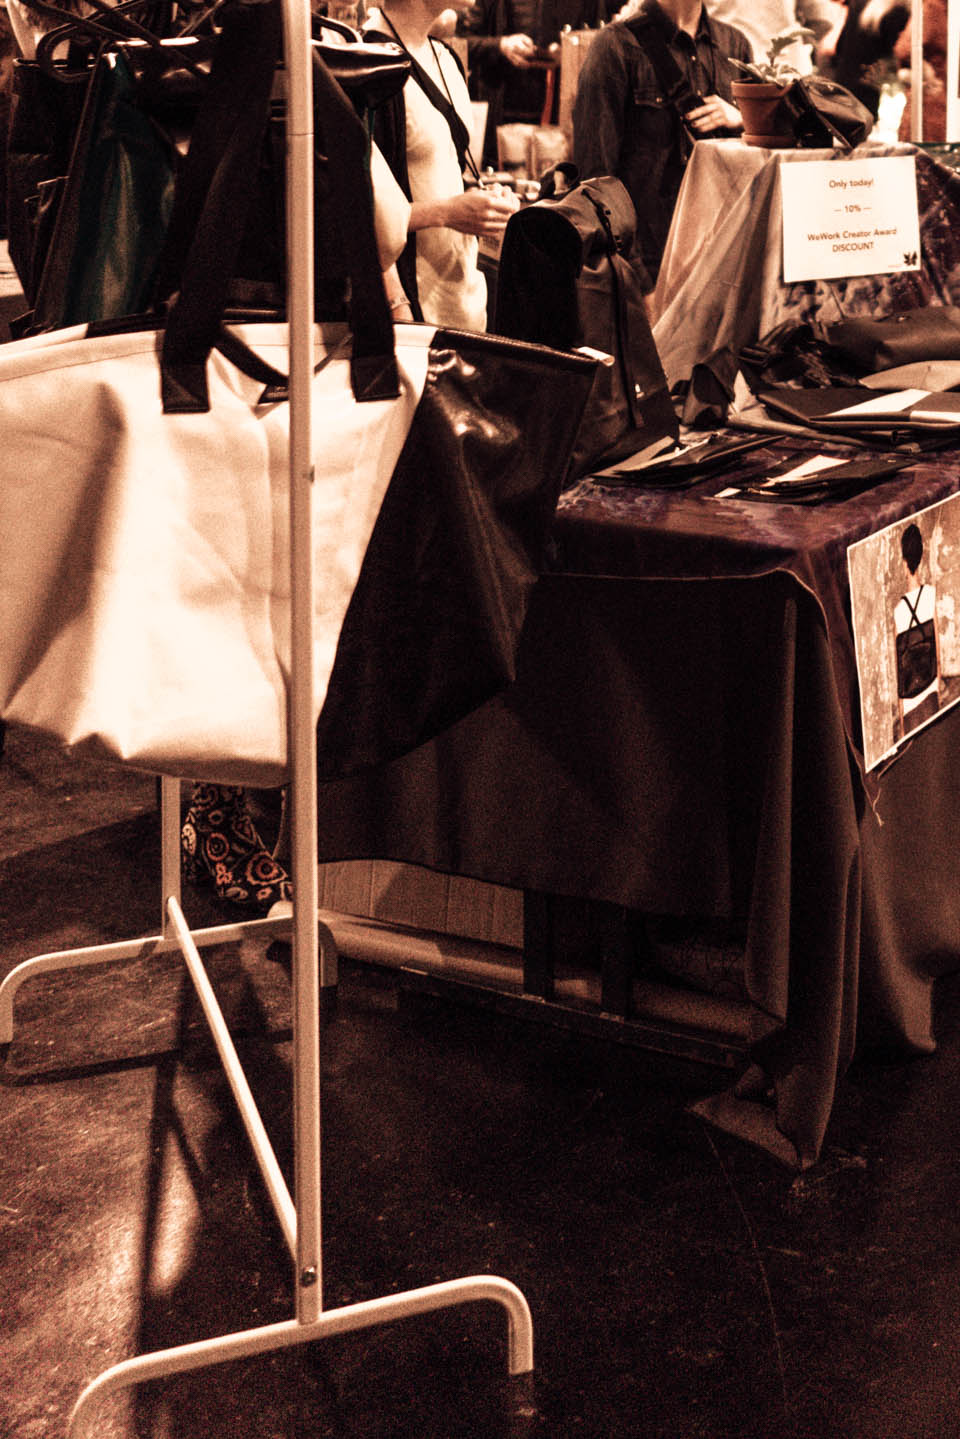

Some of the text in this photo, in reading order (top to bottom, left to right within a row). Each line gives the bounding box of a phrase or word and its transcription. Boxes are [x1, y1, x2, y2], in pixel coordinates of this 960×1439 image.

[829, 180, 847, 189] Only
[844, 204, 862, 213] 10%
[807, 228, 897, 241] WeWork Creator Award
[832, 241, 874, 252] DISCOUNT
